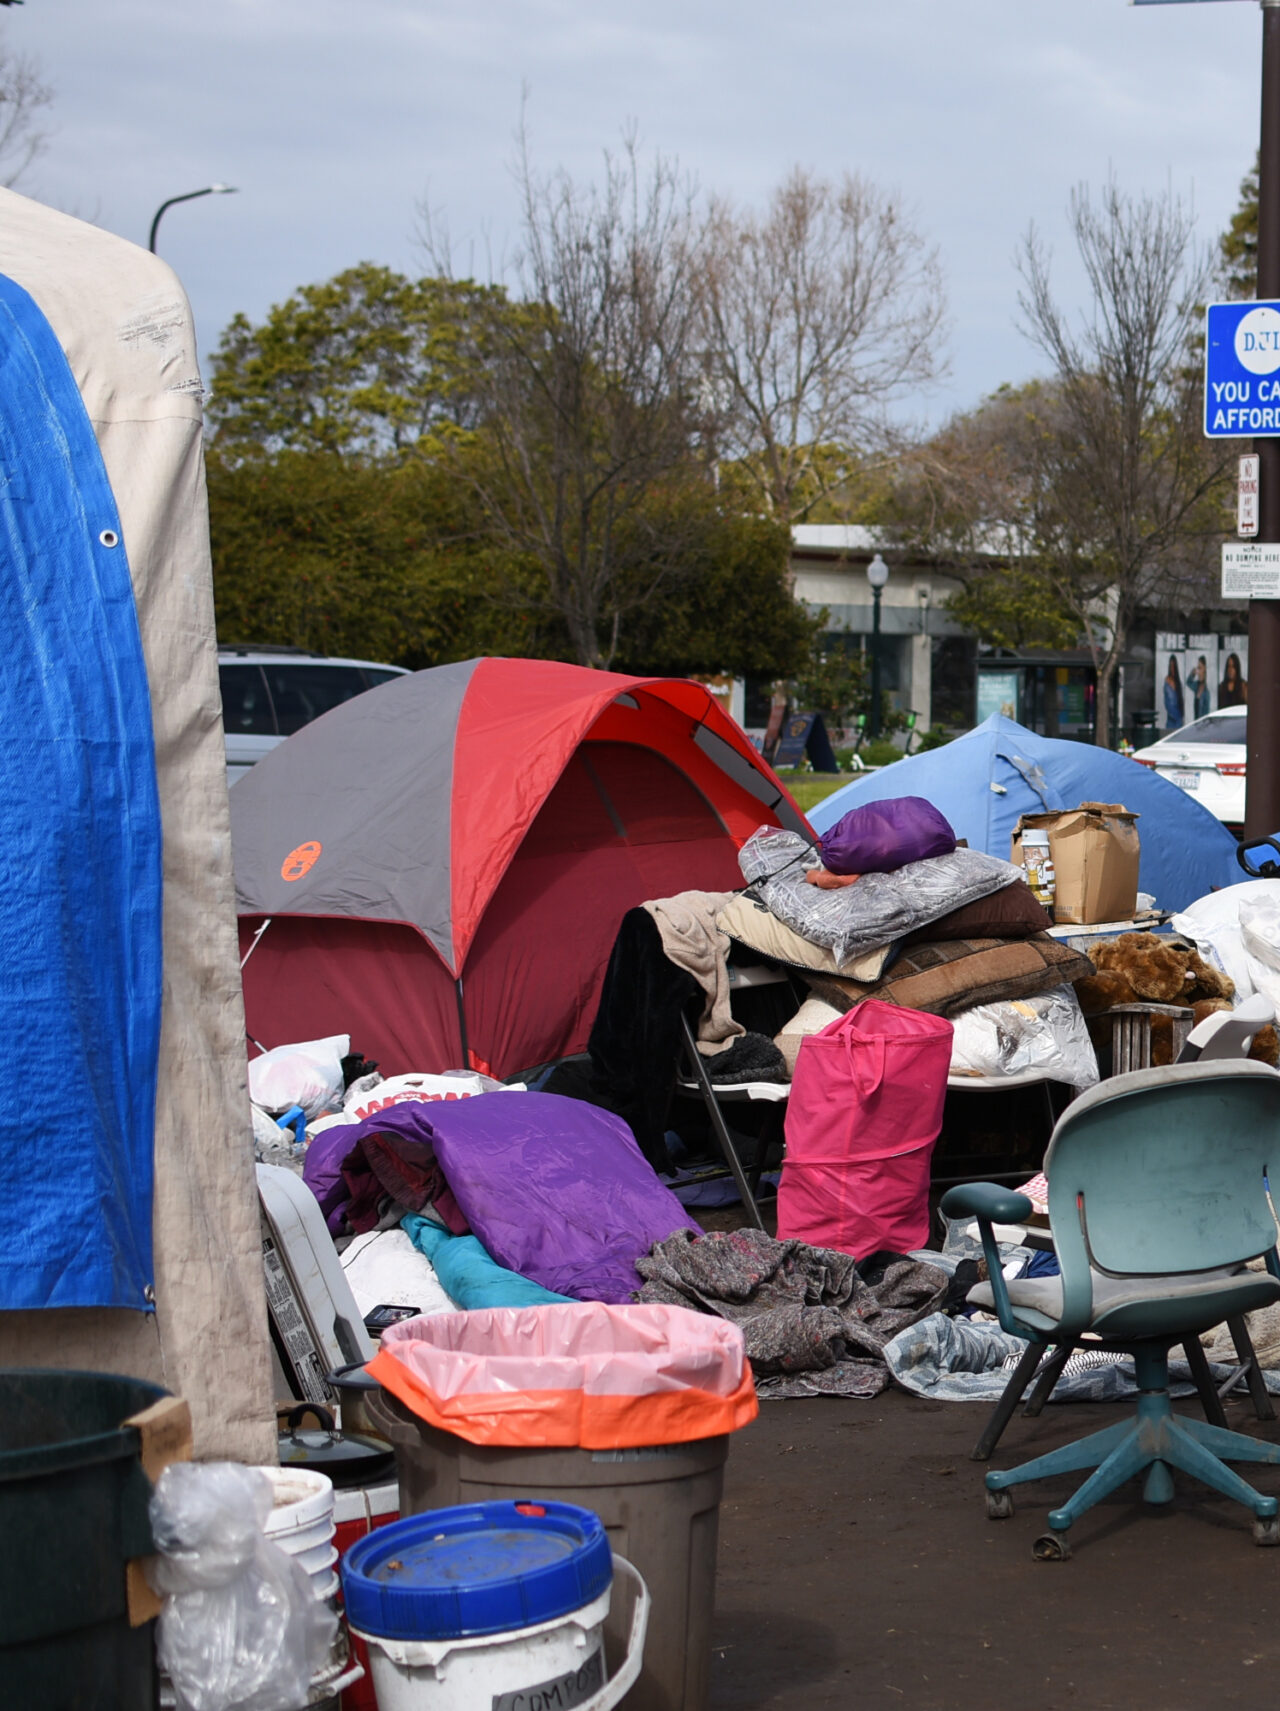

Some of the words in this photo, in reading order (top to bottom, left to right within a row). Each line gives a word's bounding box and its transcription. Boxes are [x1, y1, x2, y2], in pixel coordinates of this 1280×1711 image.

[1212, 381, 1250, 403] YOU
[1225, 554, 1233, 562] NO
[1236, 554, 1262, 562] DUMPING
[1264, 554, 1280, 562] HERE
